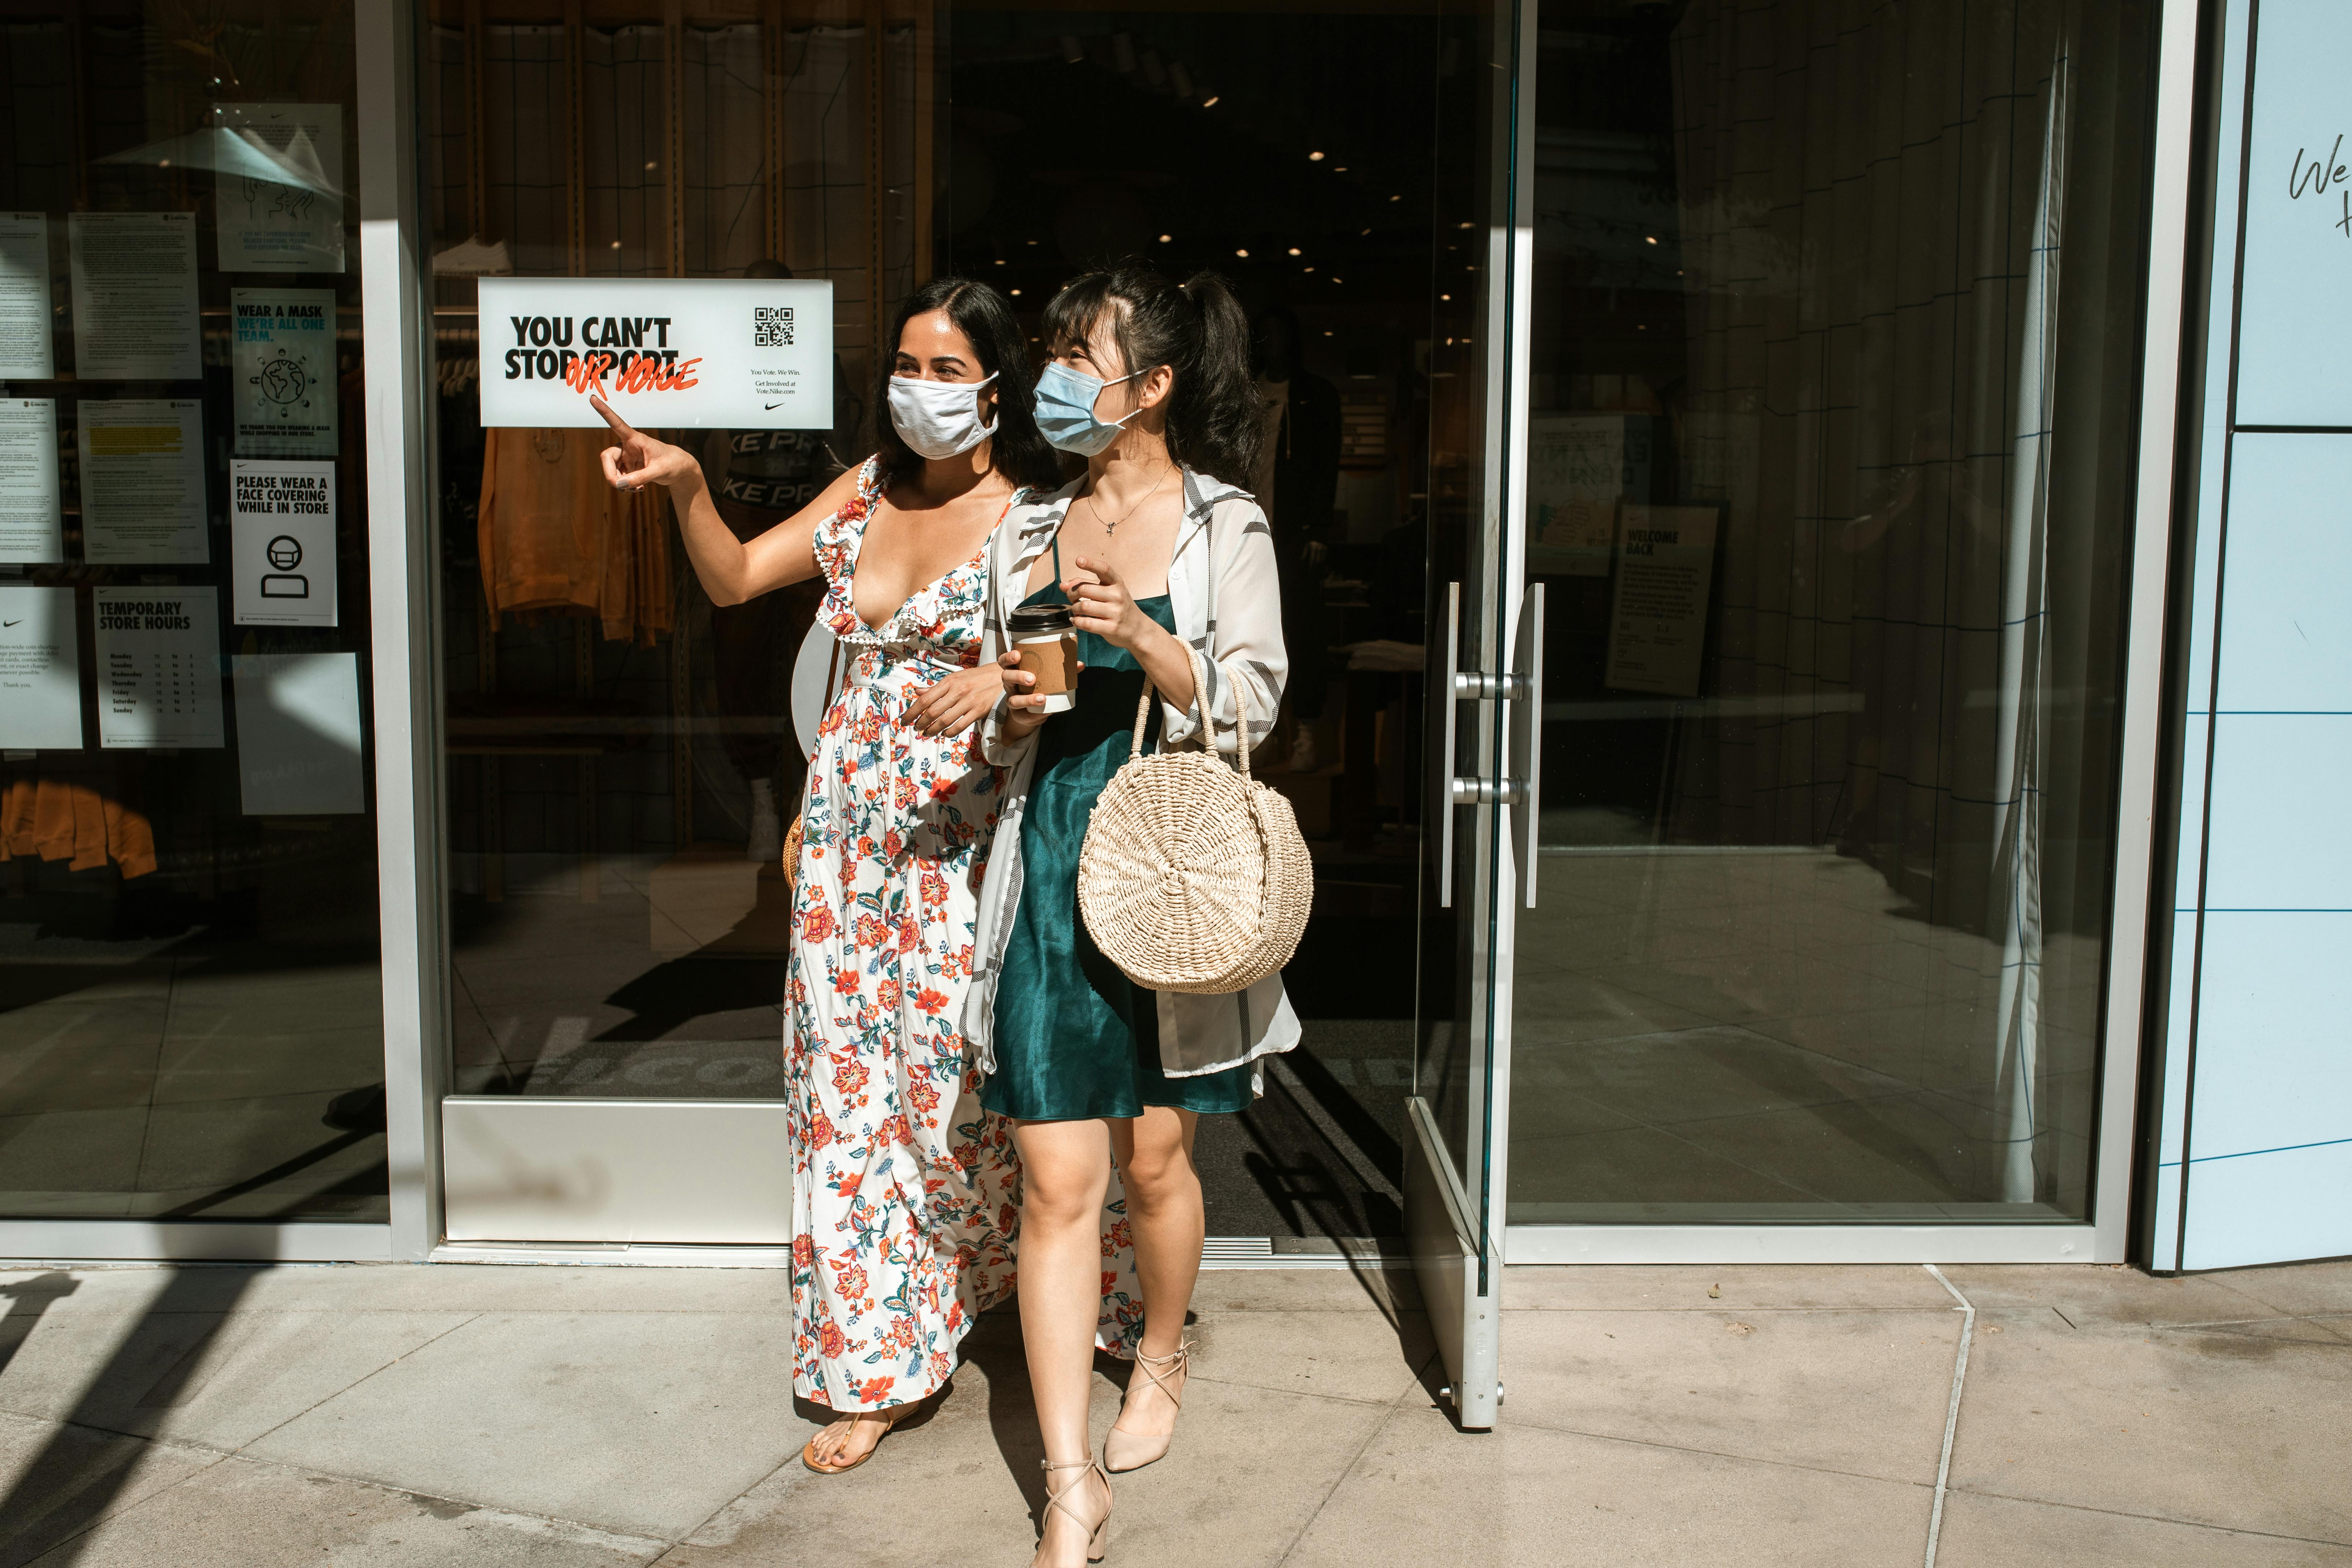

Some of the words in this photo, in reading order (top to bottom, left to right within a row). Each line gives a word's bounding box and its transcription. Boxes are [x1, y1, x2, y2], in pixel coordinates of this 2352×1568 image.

[2290, 134, 2351, 199] We
[237, 305, 271, 317] WEAR
[276, 305, 284, 317] A
[288, 306, 322, 317] MASK
[237, 318, 274, 329] WE'RE
[278, 318, 297, 329] ALL
[301, 319, 325, 330] ONE
[237, 330, 274, 342] TEAM.
[510, 316, 573, 347] YOU
[582, 316, 671, 347] CAN'T
[505, 349, 579, 380] STOP
[566, 353, 612, 401] OUR
[616, 354, 703, 394] VOICE
[237, 476, 276, 488] PLEASE
[280, 477, 315, 489] WEAR
[319, 478, 328, 489] A
[237, 489, 263, 500] FACE
[267, 489, 326, 501] COVERING
[237, 501, 273, 513] WHILE
[277, 502, 289, 514] IN
[294, 502, 329, 514] STORE
[1627, 529, 1678, 544] WELCOME
[1626, 543, 1654, 556] BACK
[99, 602, 182, 615] TEMPORARY
[100, 616, 140, 630] STORE
[145, 616, 190, 630] HOURS
